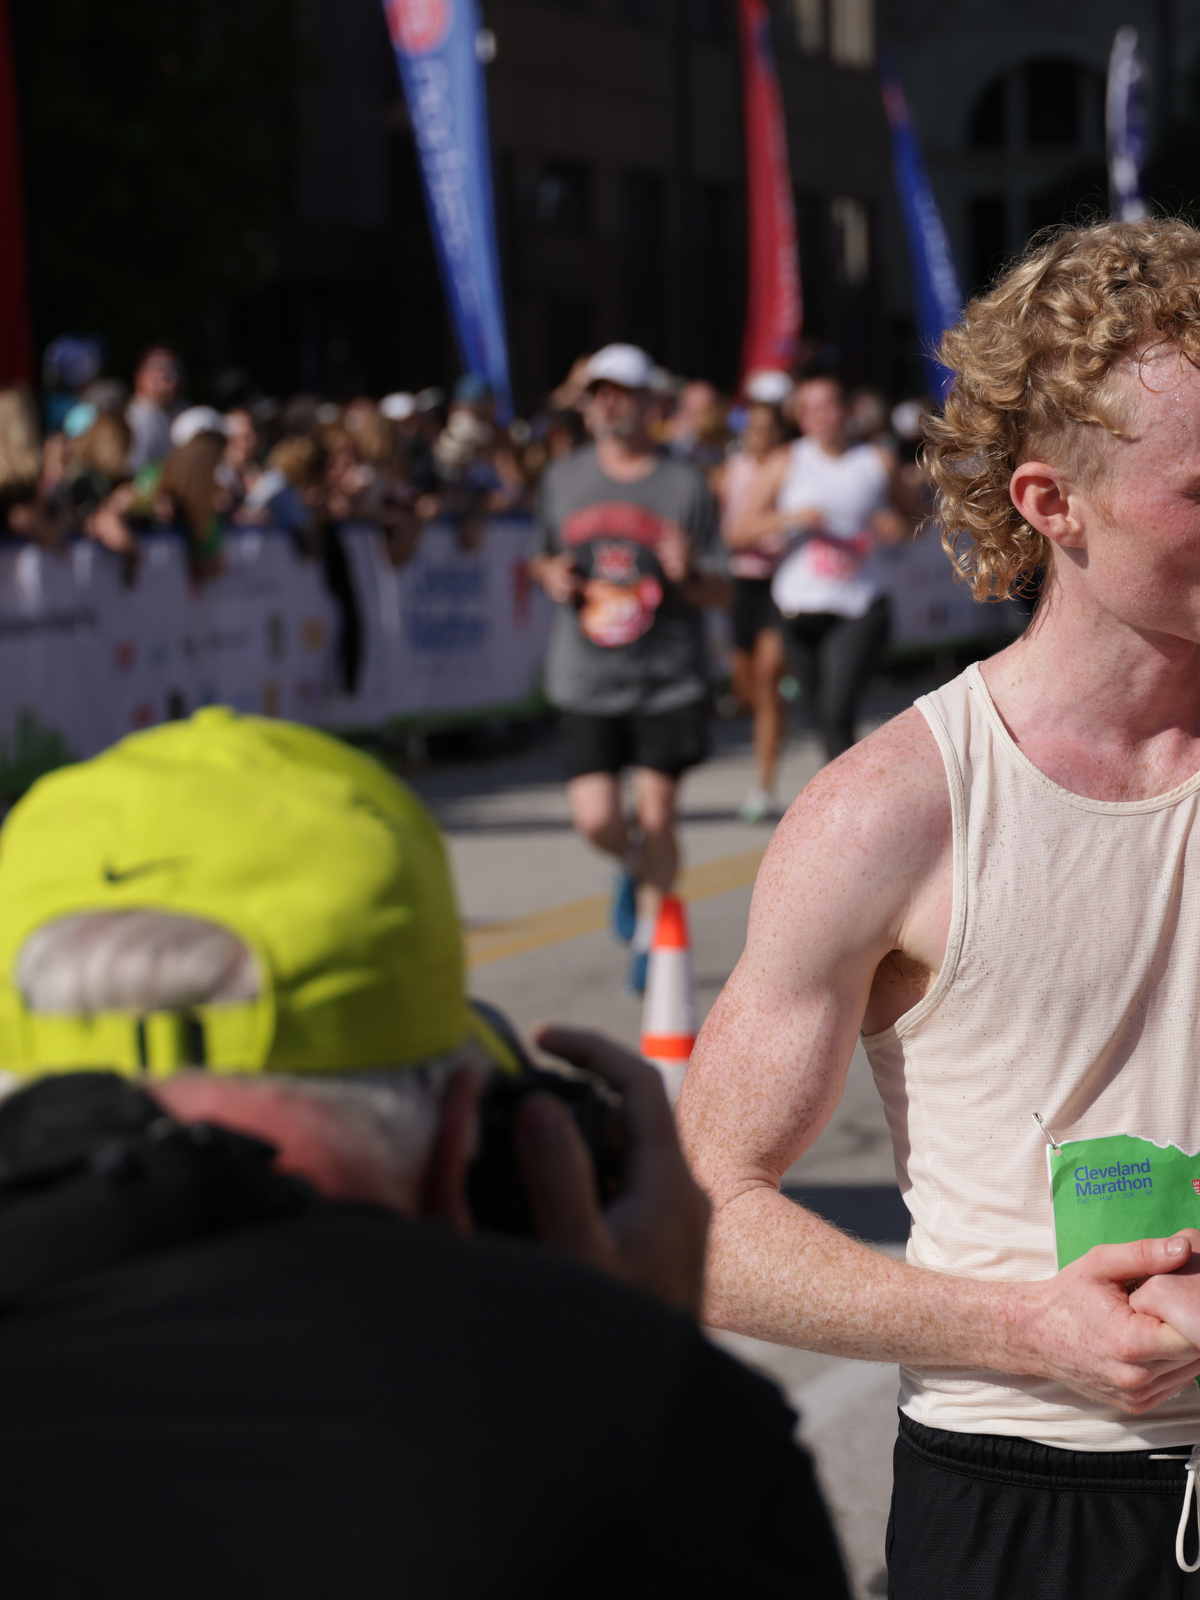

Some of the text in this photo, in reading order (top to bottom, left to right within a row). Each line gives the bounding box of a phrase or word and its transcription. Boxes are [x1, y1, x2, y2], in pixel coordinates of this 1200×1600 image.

[1074, 1157, 1151, 1181] Cleveland
[1075, 1176, 1153, 1197] Marathon
[1122, 1191, 1135, 1199] 10K
